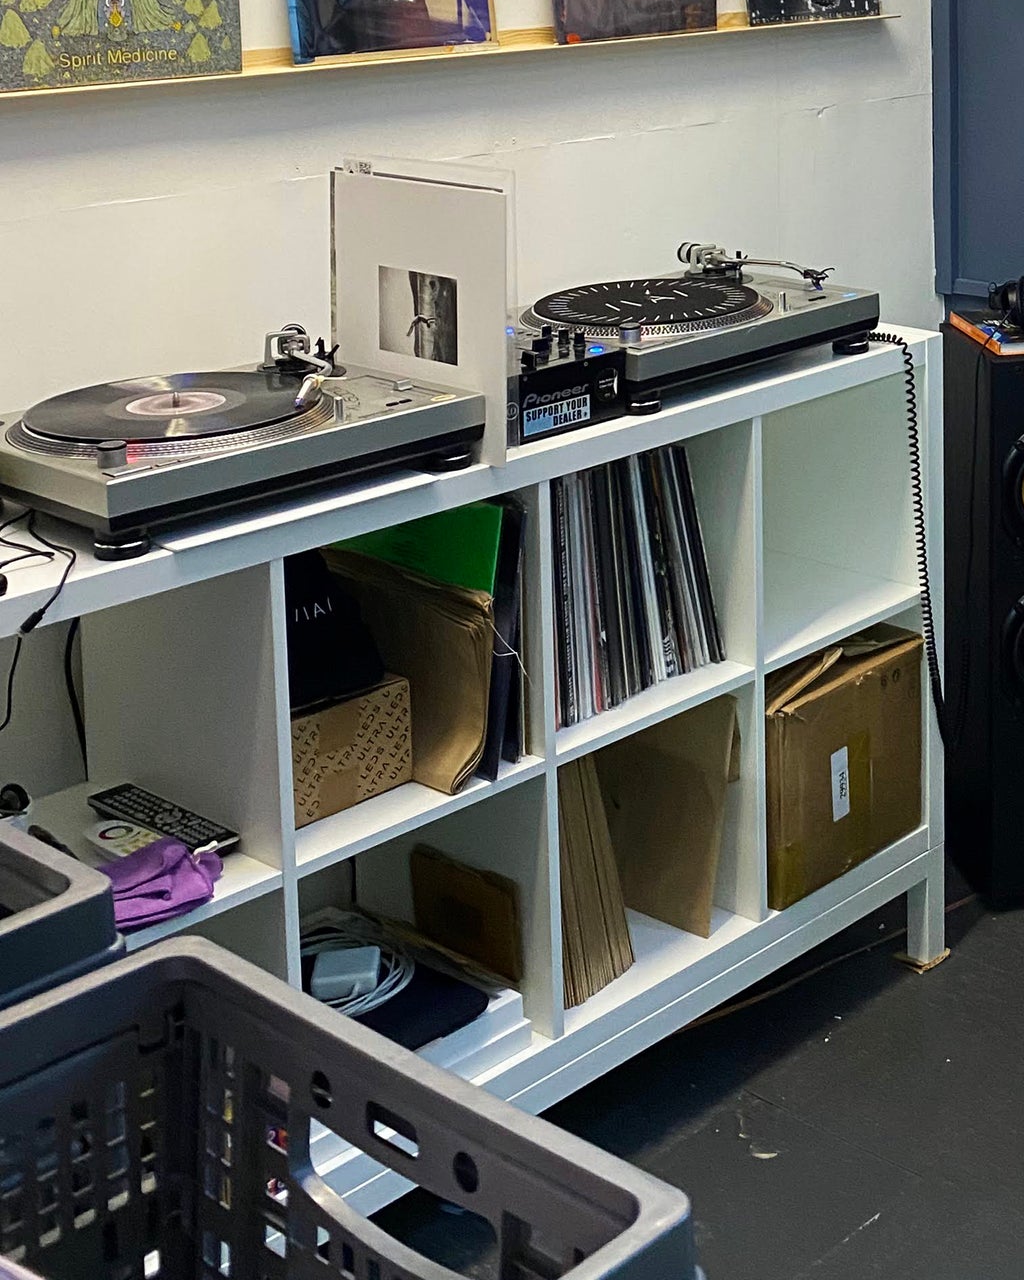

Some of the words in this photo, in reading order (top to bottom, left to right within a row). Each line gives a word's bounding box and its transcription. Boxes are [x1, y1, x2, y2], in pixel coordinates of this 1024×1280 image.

[60, 52, 102, 70] Spirit
[106, 48, 178, 65] Medicine
[522, 383, 589, 408] Pioneer
[526, 403, 564, 422] SUPPORT
[566, 397, 588, 412] YOUR
[553, 409, 582, 426] DEALER
[357, 720, 387, 761] ULTRA
[298, 765, 329, 807] ULTRA
